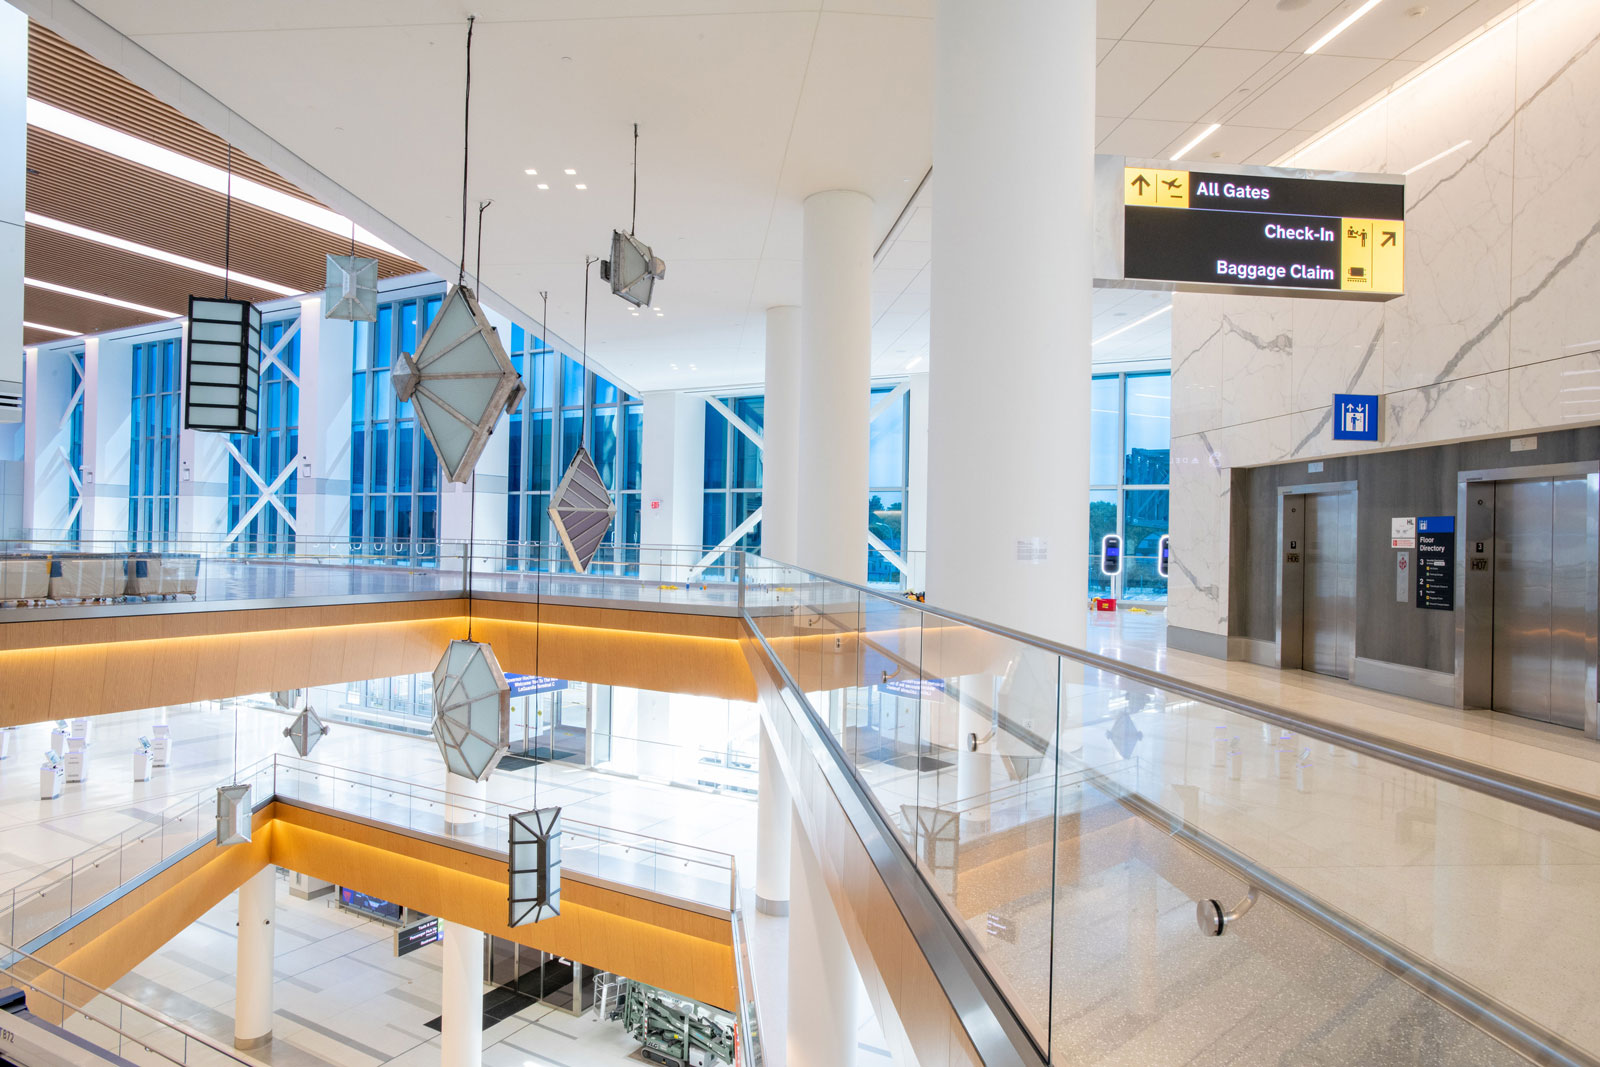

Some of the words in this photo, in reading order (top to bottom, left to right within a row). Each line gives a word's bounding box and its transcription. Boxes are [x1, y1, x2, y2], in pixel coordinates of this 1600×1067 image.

[1196, 181, 1219, 198] All
[1223, 183, 1270, 200] Gates
[1264, 223, 1335, 242] Check-In
[1216, 260, 1286, 281] Baggage
[1290, 264, 1335, 281] Claim
[1420, 544, 1445, 553] Directory
[1419, 558, 1424, 566] 3
